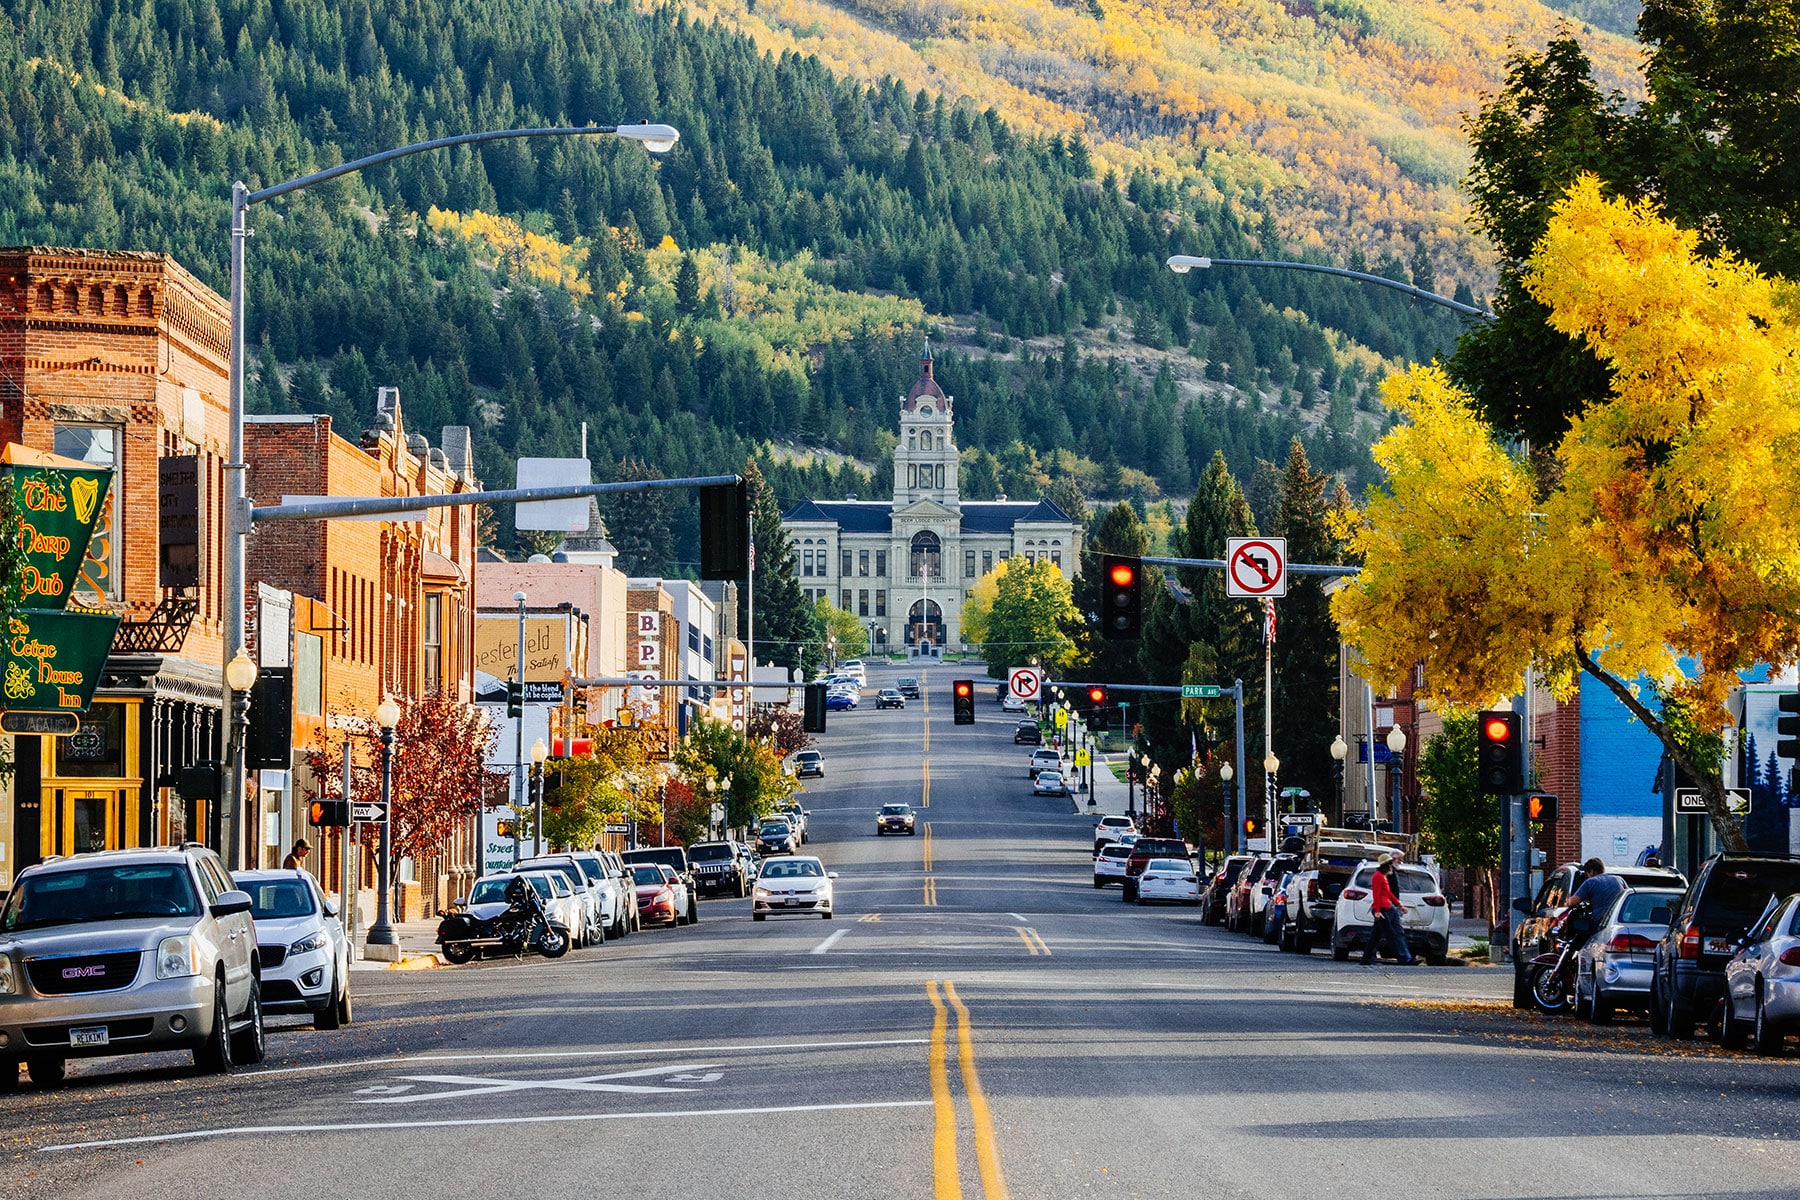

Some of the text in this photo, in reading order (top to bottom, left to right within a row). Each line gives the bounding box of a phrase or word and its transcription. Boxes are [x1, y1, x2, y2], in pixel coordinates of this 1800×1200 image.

[22, 477, 67, 512] The
[11, 636, 58, 658] Celtic
[529, 654, 560, 670] Satisfy
[38, 656, 84, 684] House
[529, 683, 541, 692] the
[541, 683, 559, 692] blend
[1185, 687, 1203, 695] PARK
[59, 687, 82, 707] Inn
[532, 691, 541, 699] be
[23, 716, 71, 732] VACANCY
[1684, 795, 1705, 806] ONE
[353, 808, 370, 816] WAY
[485, 859, 514, 870] ountain
[62, 965, 106, 979] GMC
